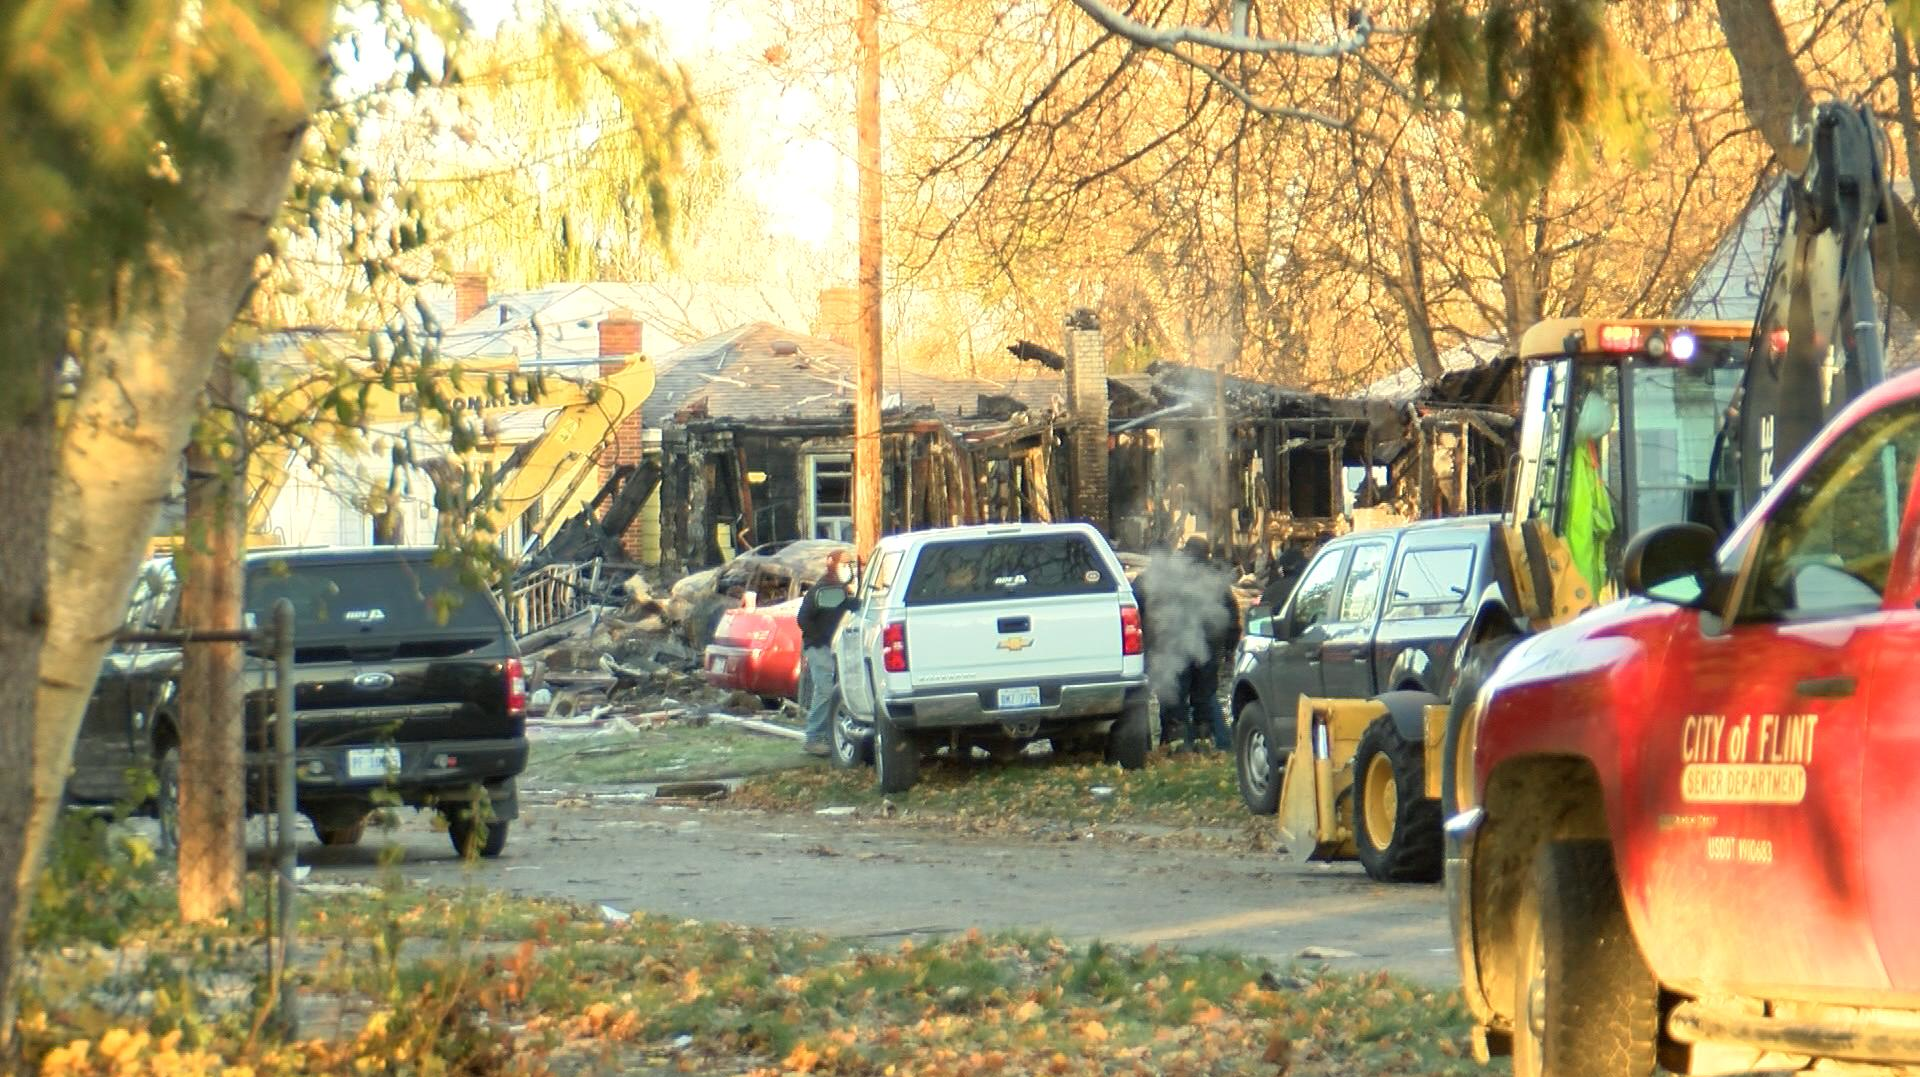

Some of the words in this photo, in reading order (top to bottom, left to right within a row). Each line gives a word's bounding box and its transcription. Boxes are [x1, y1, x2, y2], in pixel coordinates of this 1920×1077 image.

[446, 391, 533, 410] OMATSU
[1682, 715, 1726, 762] CITY
[1729, 714, 1751, 762] of
[1758, 714, 1819, 764] FLINT
[1687, 769, 1723, 795] SEWER
[1727, 769, 1804, 795] DEPARTMENT
[1708, 836, 1736, 861] USDOT
